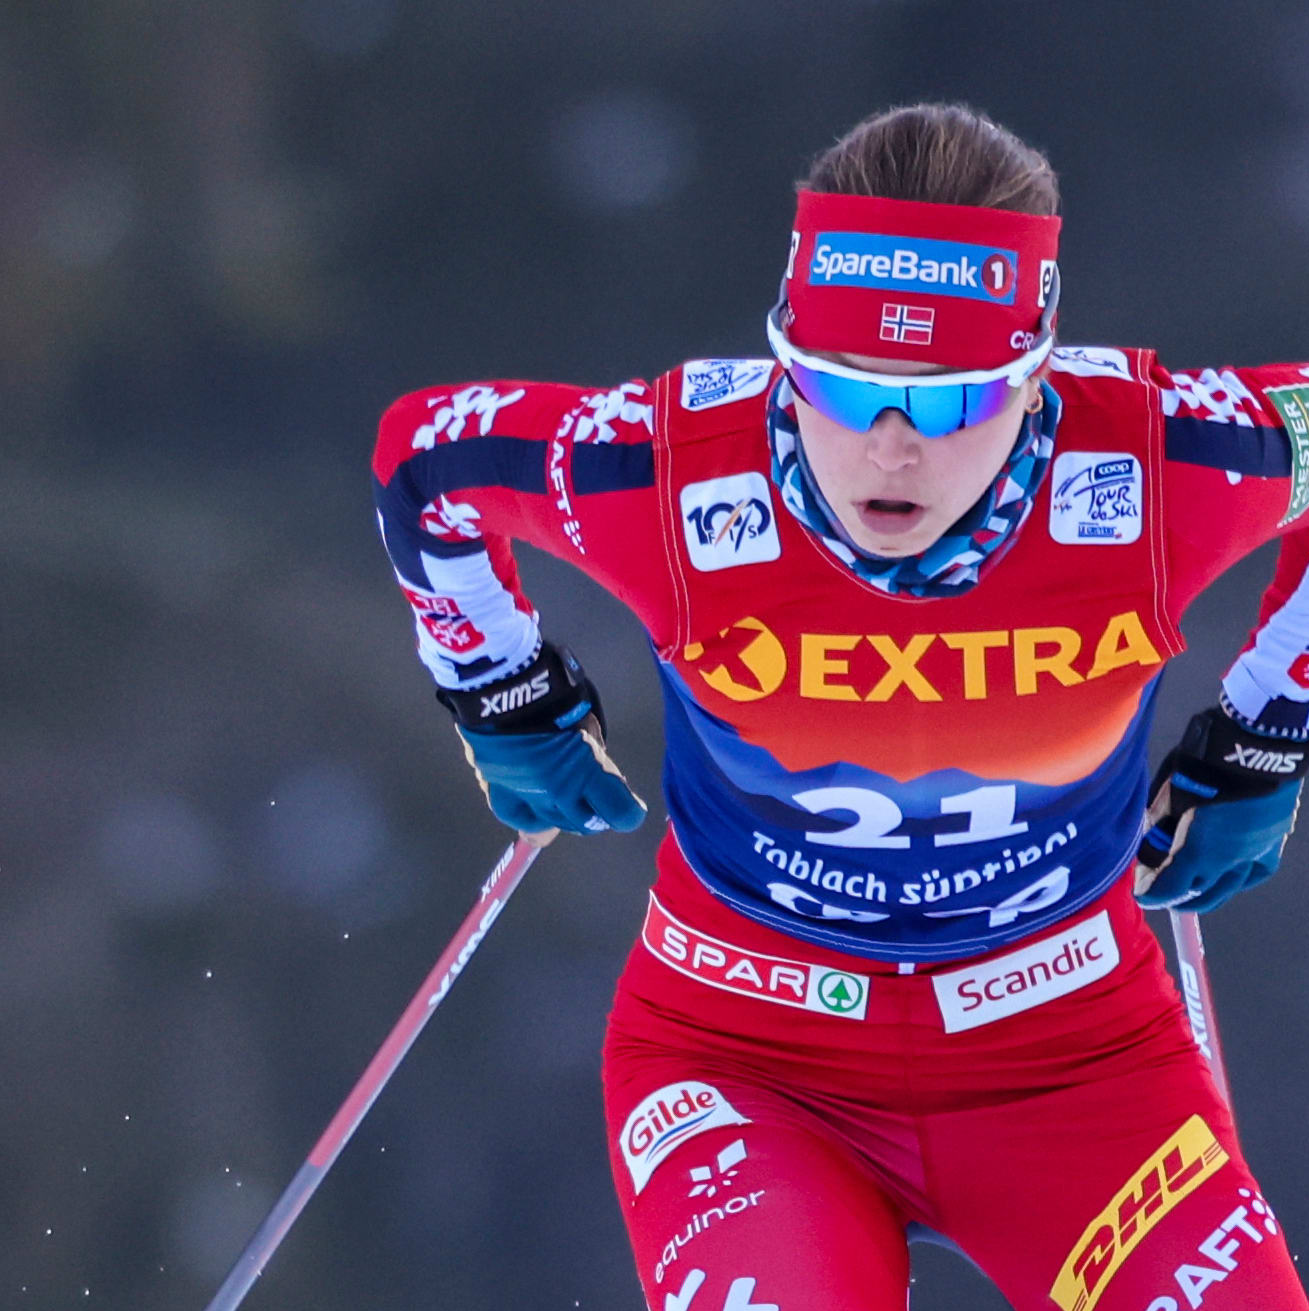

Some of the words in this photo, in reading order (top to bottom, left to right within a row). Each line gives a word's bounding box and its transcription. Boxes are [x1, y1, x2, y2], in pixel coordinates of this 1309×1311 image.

[813, 244, 978, 288] SpareBank
[800, 610, 1162, 702] EXTRA
[792, 784, 1029, 849] 21
[752, 831, 887, 903] Toblach
[660, 925, 806, 998] SPAR
[955, 933, 1104, 1012] Scandic
[627, 1087, 718, 1158] Gilde
[653, 1188, 766, 1285] equinor
[1071, 1147, 1204, 1290] DHL
